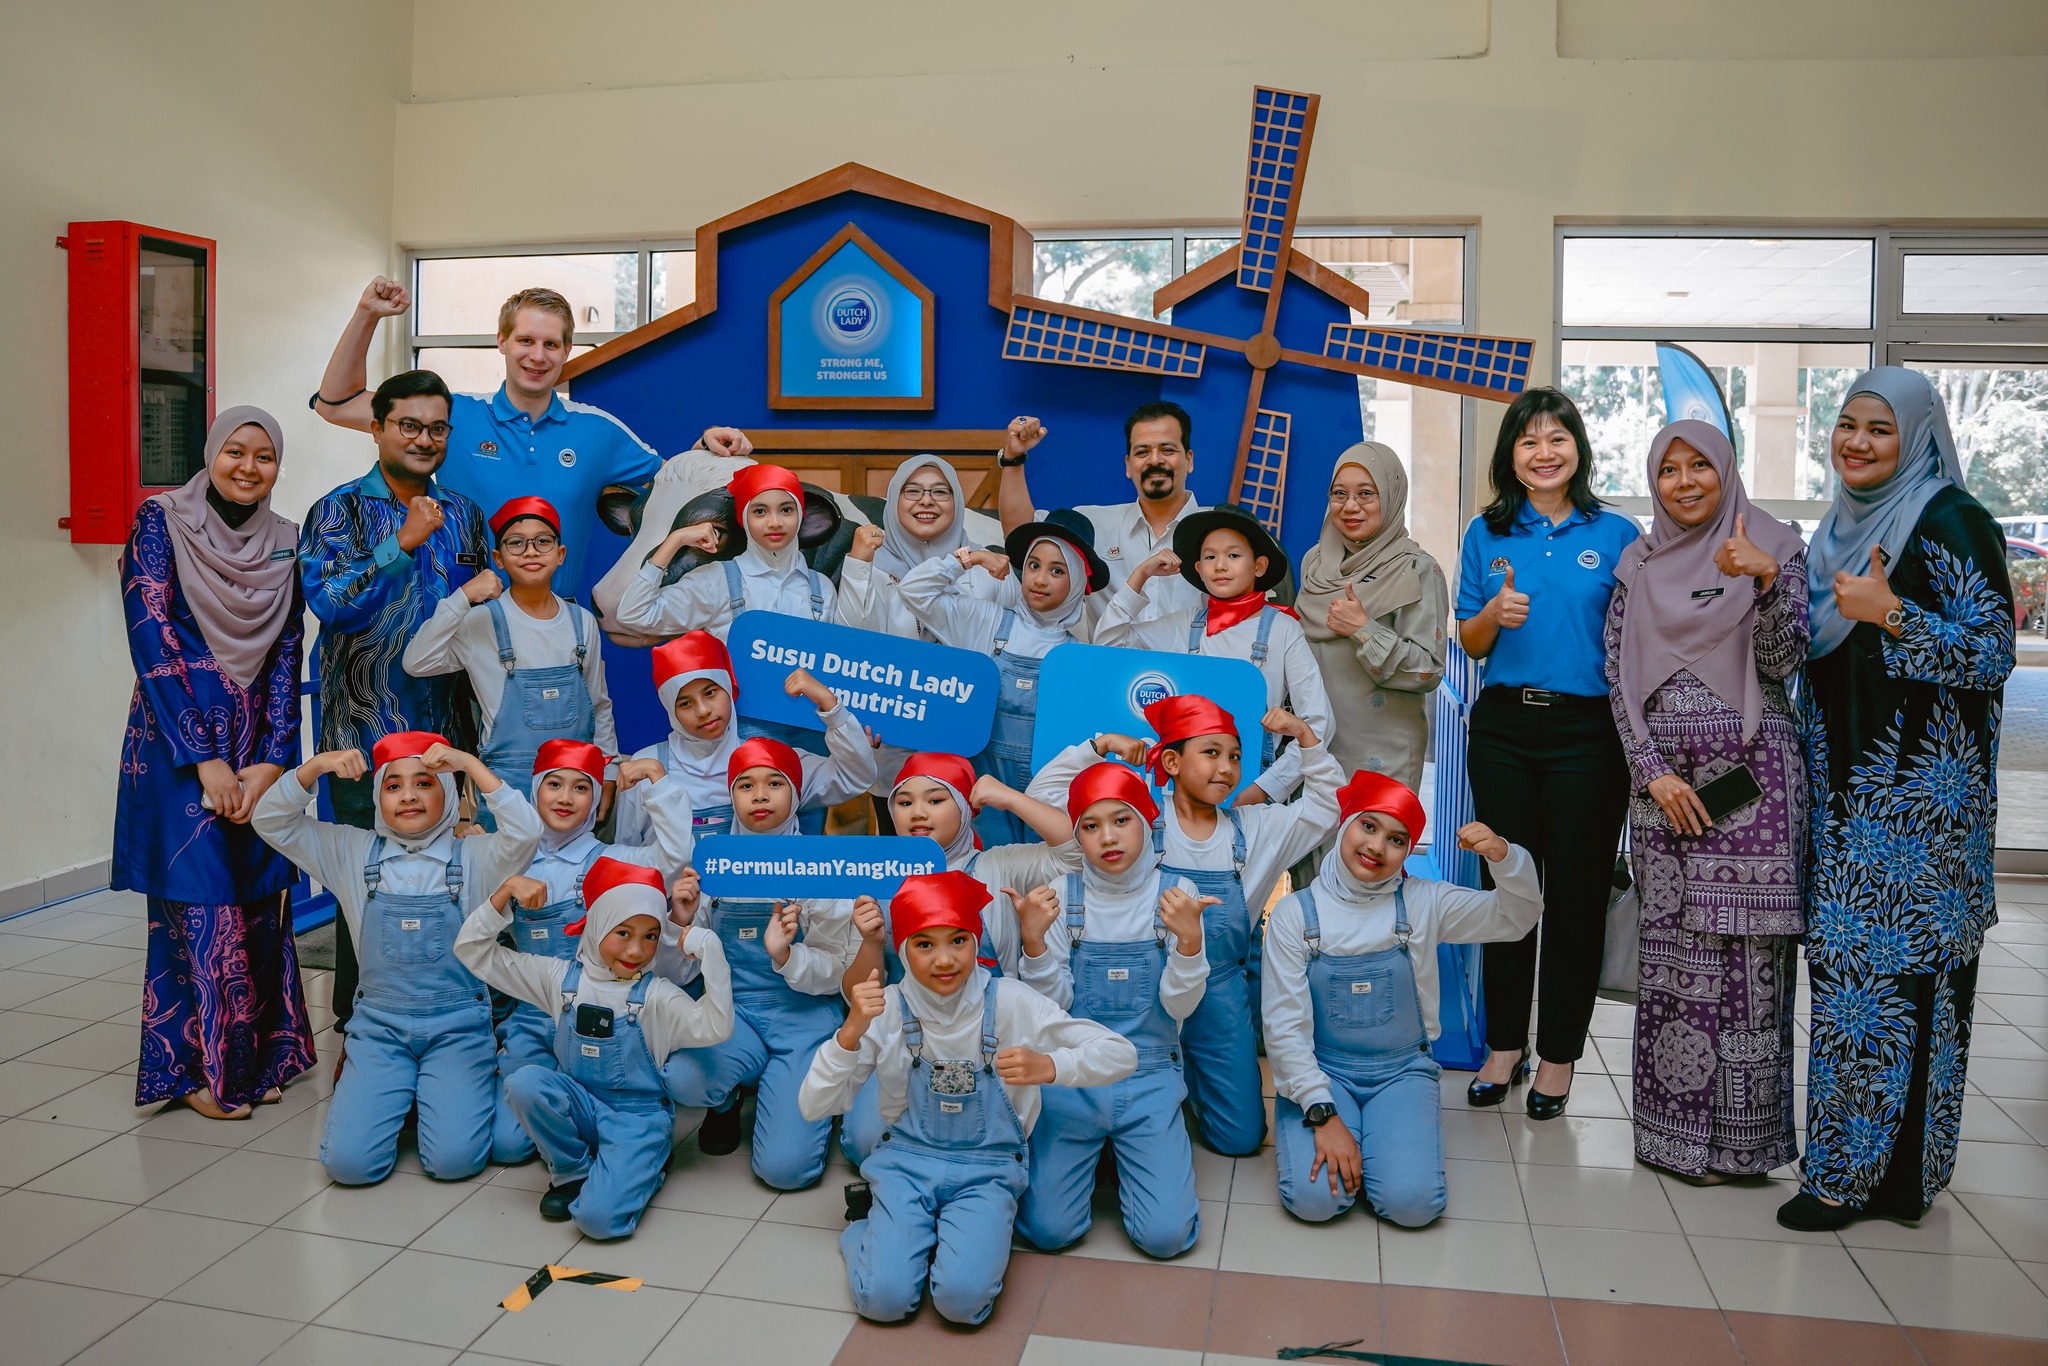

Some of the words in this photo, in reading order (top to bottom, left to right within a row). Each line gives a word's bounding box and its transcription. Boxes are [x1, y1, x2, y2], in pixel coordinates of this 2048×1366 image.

[837, 308, 867, 316] DUTCH
[840, 316, 863, 325] LADY
[820, 358, 862, 368] STRONG
[864, 358, 884, 369] ME,
[816, 370, 871, 380] STRONGER
[873, 370, 887, 380] US
[751, 639, 816, 670] Susu
[822, 652, 903, 687] Dutch
[909, 669, 975, 704] Lady
[1140, 690, 1166, 699] DUTCH
[705, 858, 935, 880] #PermulaanYangKuat
